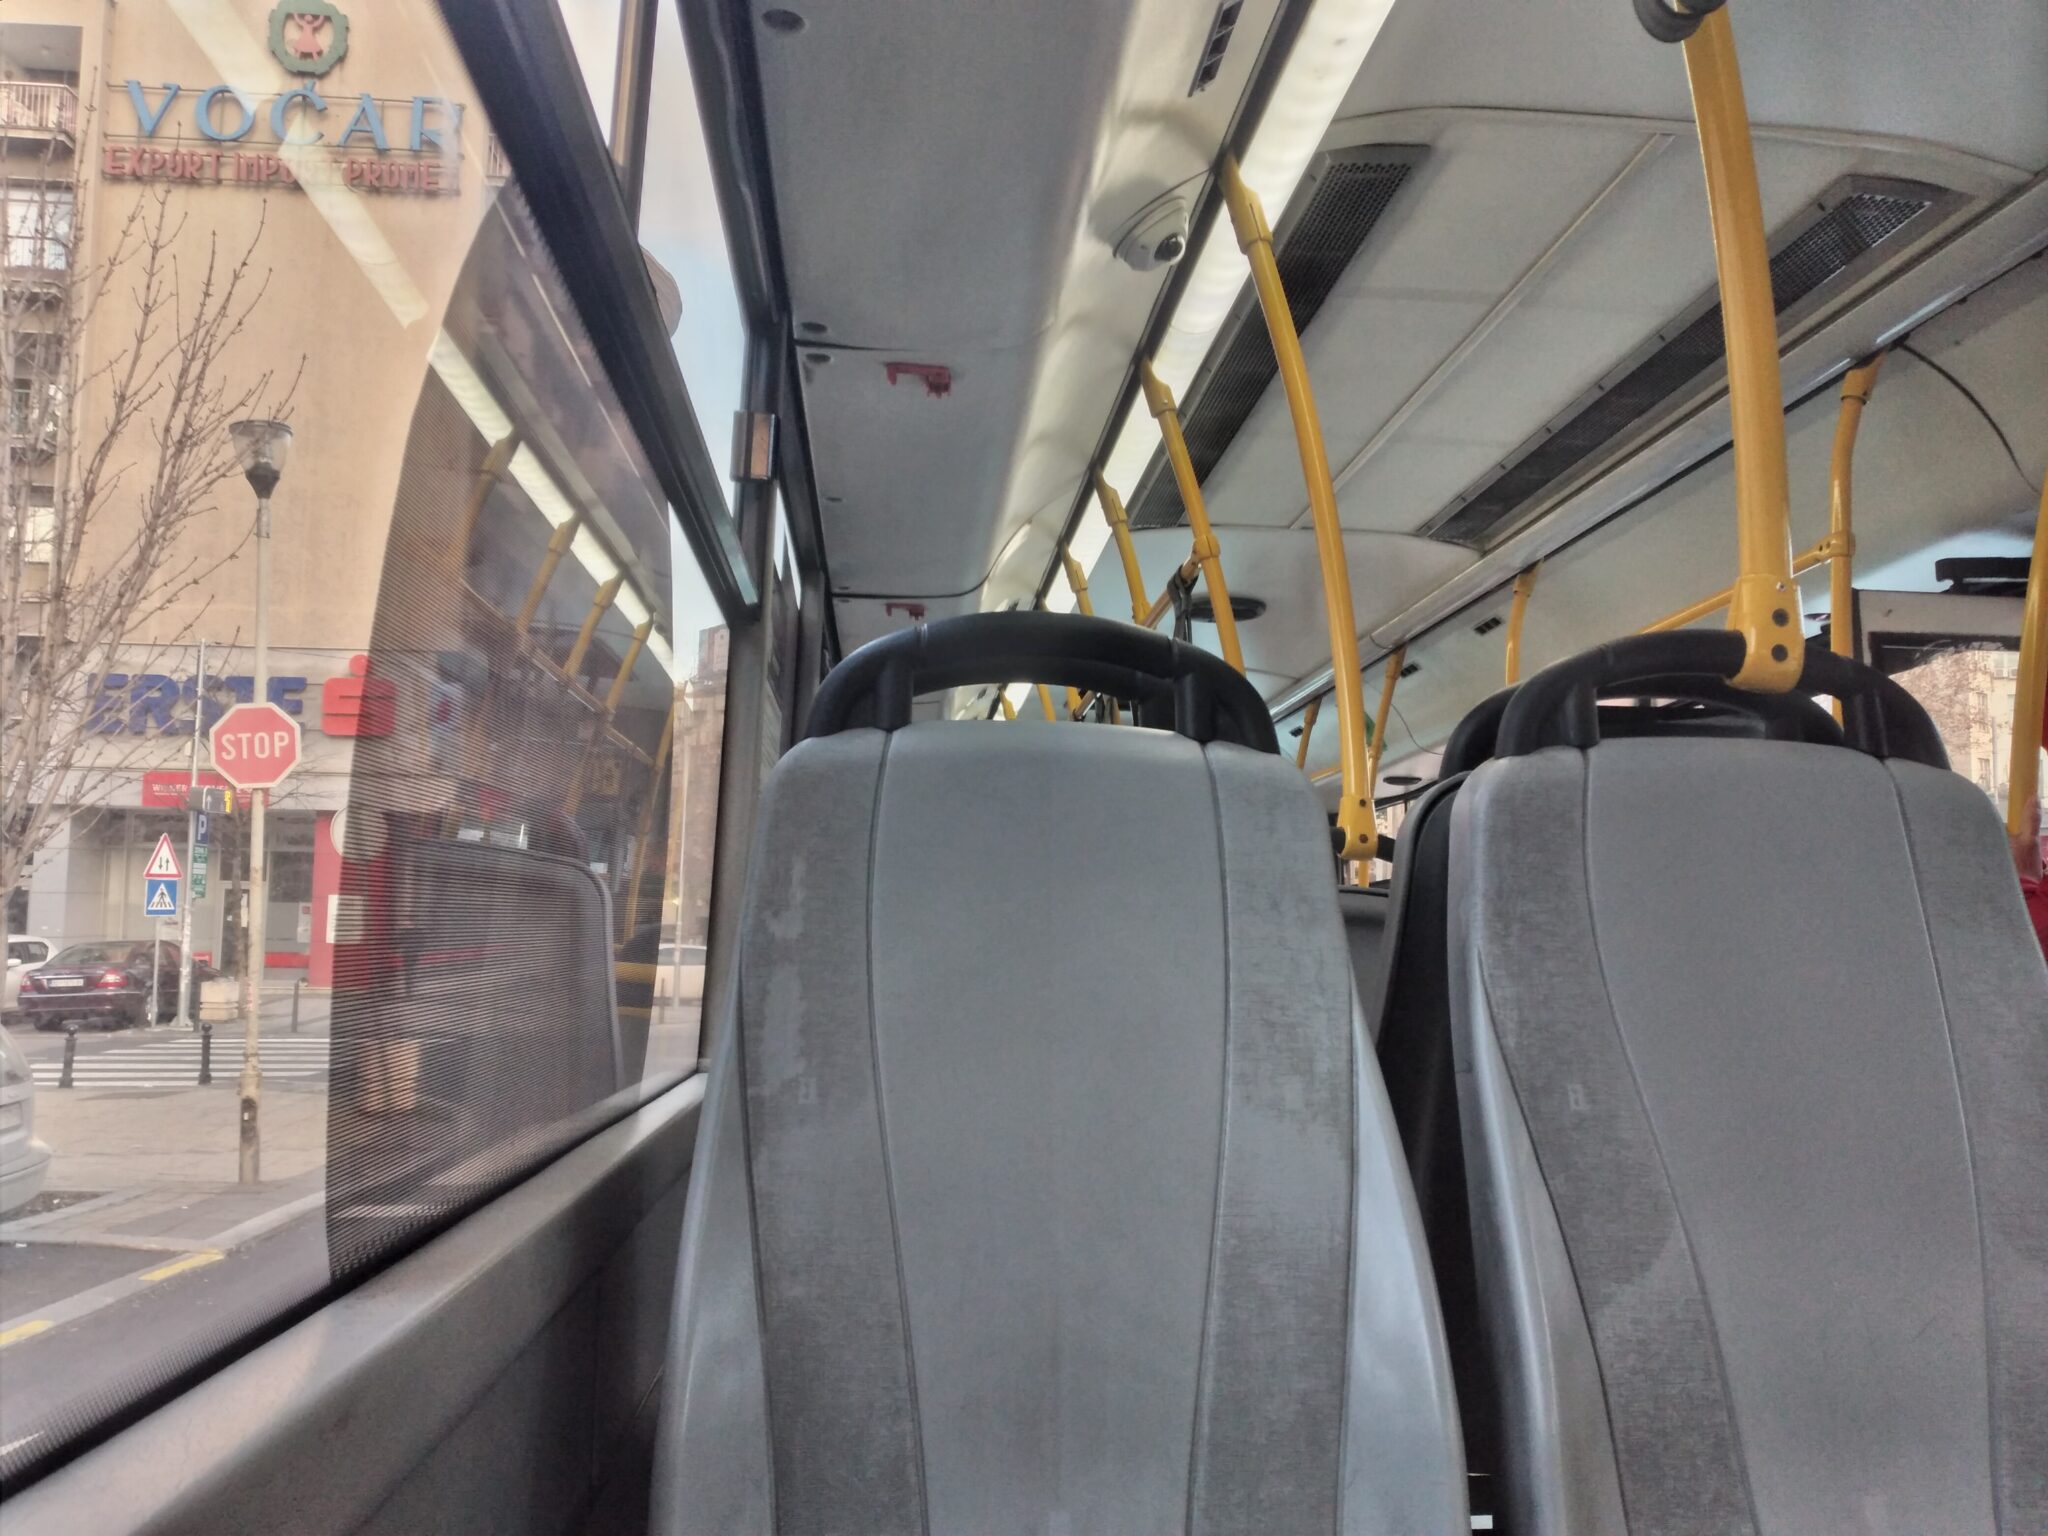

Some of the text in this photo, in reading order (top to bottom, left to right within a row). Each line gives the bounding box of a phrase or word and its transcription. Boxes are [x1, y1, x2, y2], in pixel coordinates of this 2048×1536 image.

[104, 145, 223, 179] EXPORT
[346, 158, 457, 192] PROME
[221, 731, 290, 761] STOP
[197, 814, 207, 840] P
